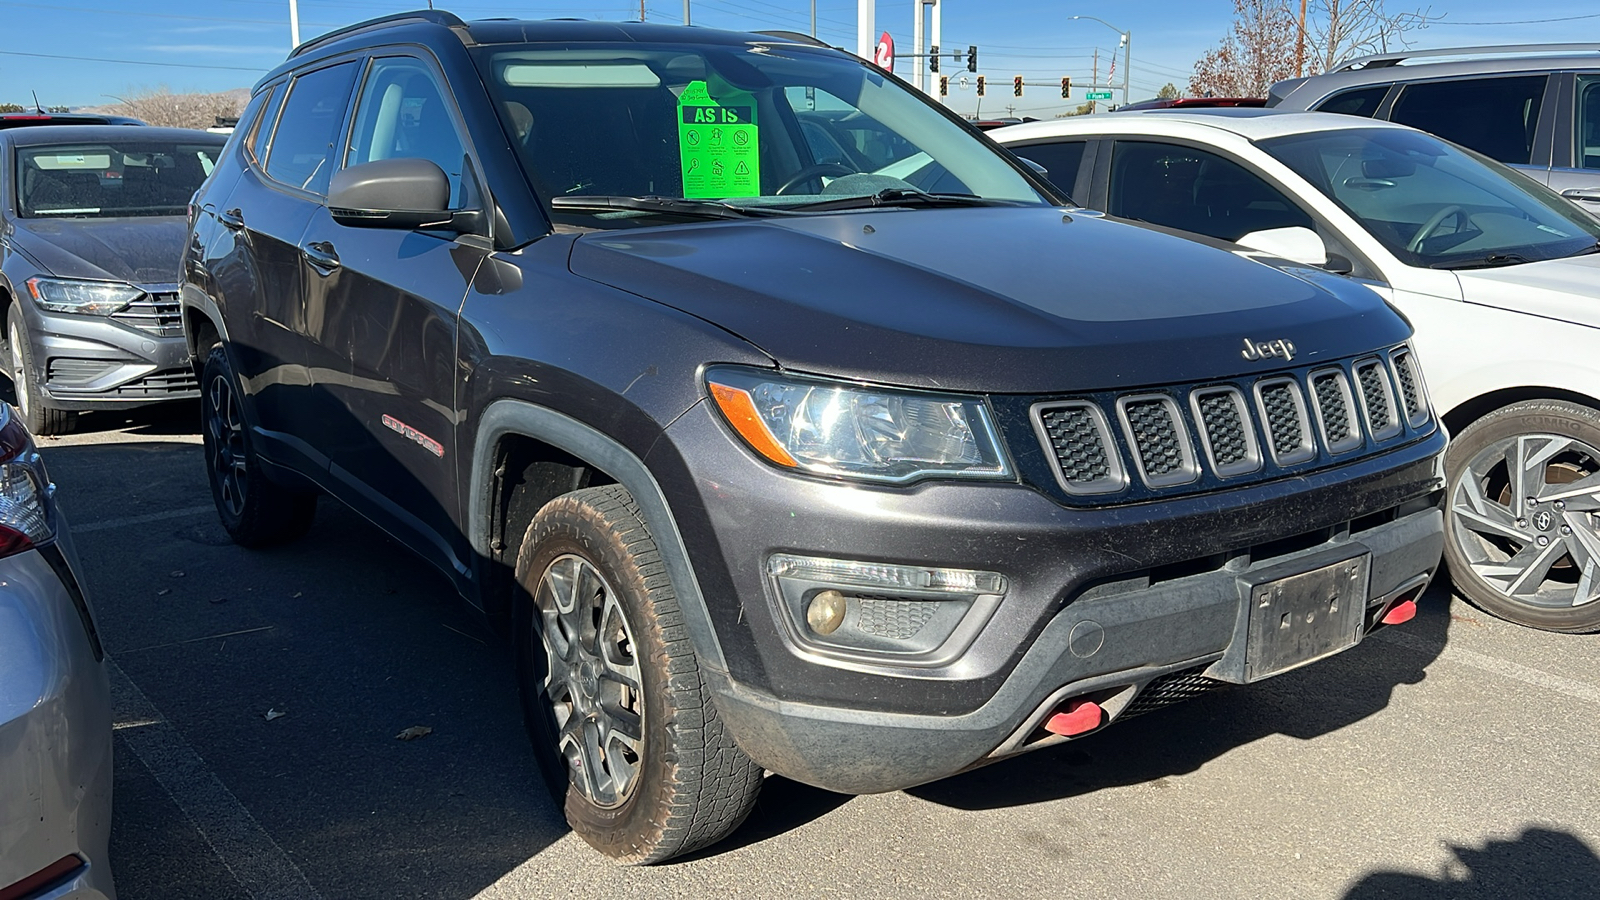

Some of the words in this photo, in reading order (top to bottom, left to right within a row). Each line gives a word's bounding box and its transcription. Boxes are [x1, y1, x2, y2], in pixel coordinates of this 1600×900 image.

[694, 108, 716, 123] AS
[721, 108, 739, 123] IS
[1241, 337, 1297, 361] Jeep
[1521, 416, 1581, 431] KUMHO
